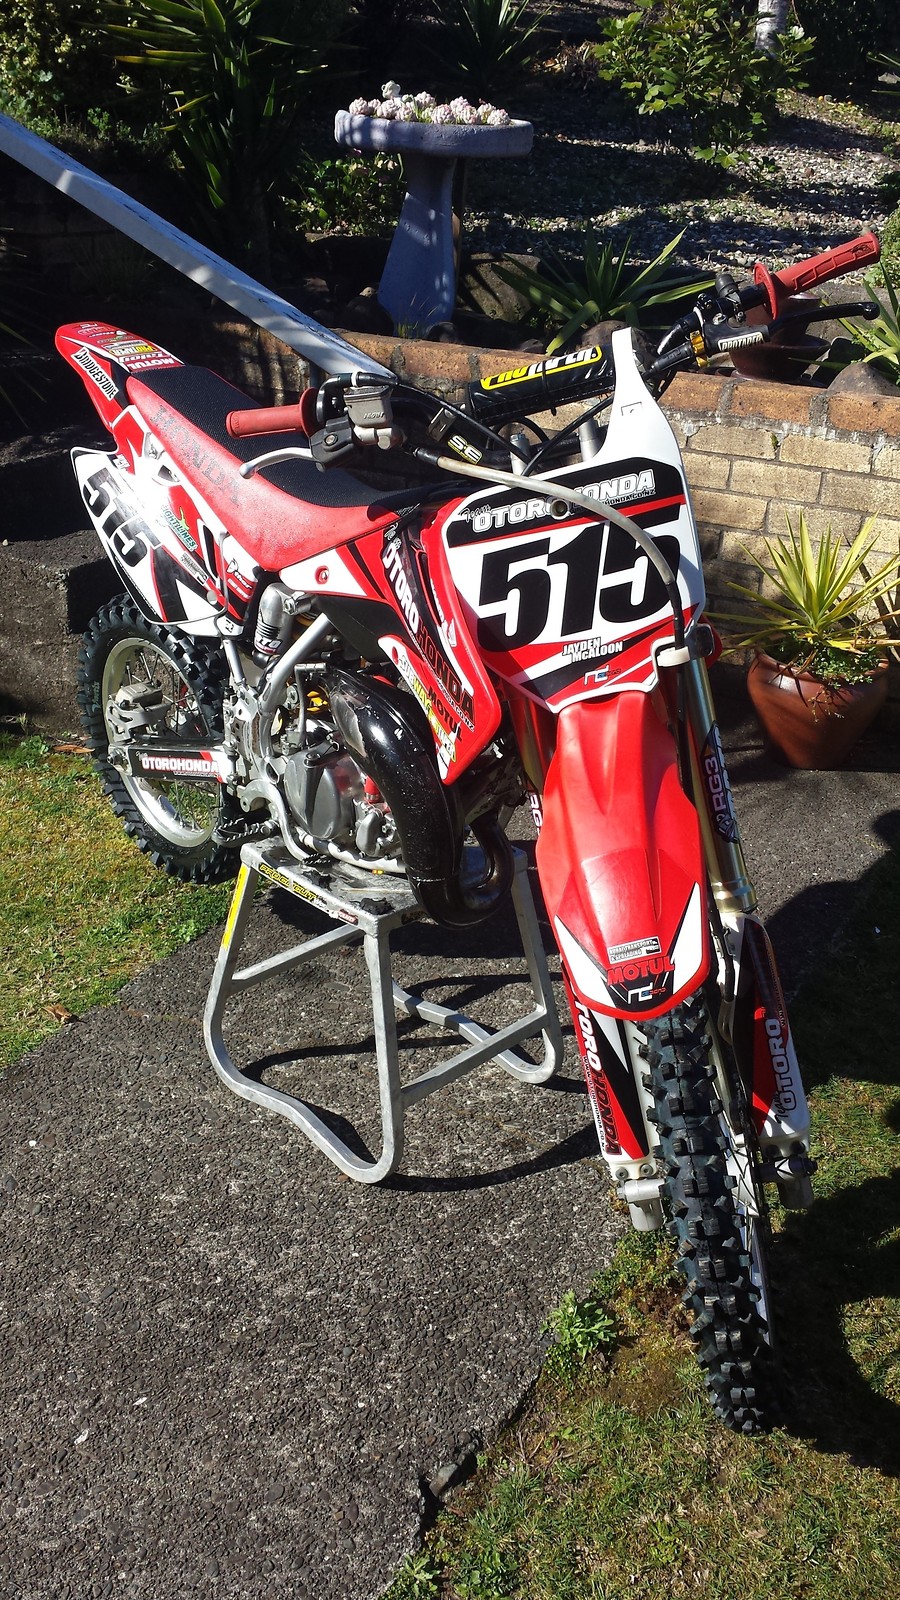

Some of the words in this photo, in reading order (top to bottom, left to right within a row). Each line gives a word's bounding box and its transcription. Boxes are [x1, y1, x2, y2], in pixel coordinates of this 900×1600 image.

[74, 348, 117, 399] BRIDGESTONE
[127, 358, 174, 369] MOTUL
[83, 467, 161, 567] 515
[477, 504, 681, 652] 515
[562, 637, 601, 656] JAYDEN
[428, 686, 463, 742] MOTUL
[141, 757, 219, 773] OTOROHONDA
[705, 757, 727, 812] RG3
[607, 956, 675, 986] MOTUL
[576, 1000, 622, 1156] TOROHONDA
